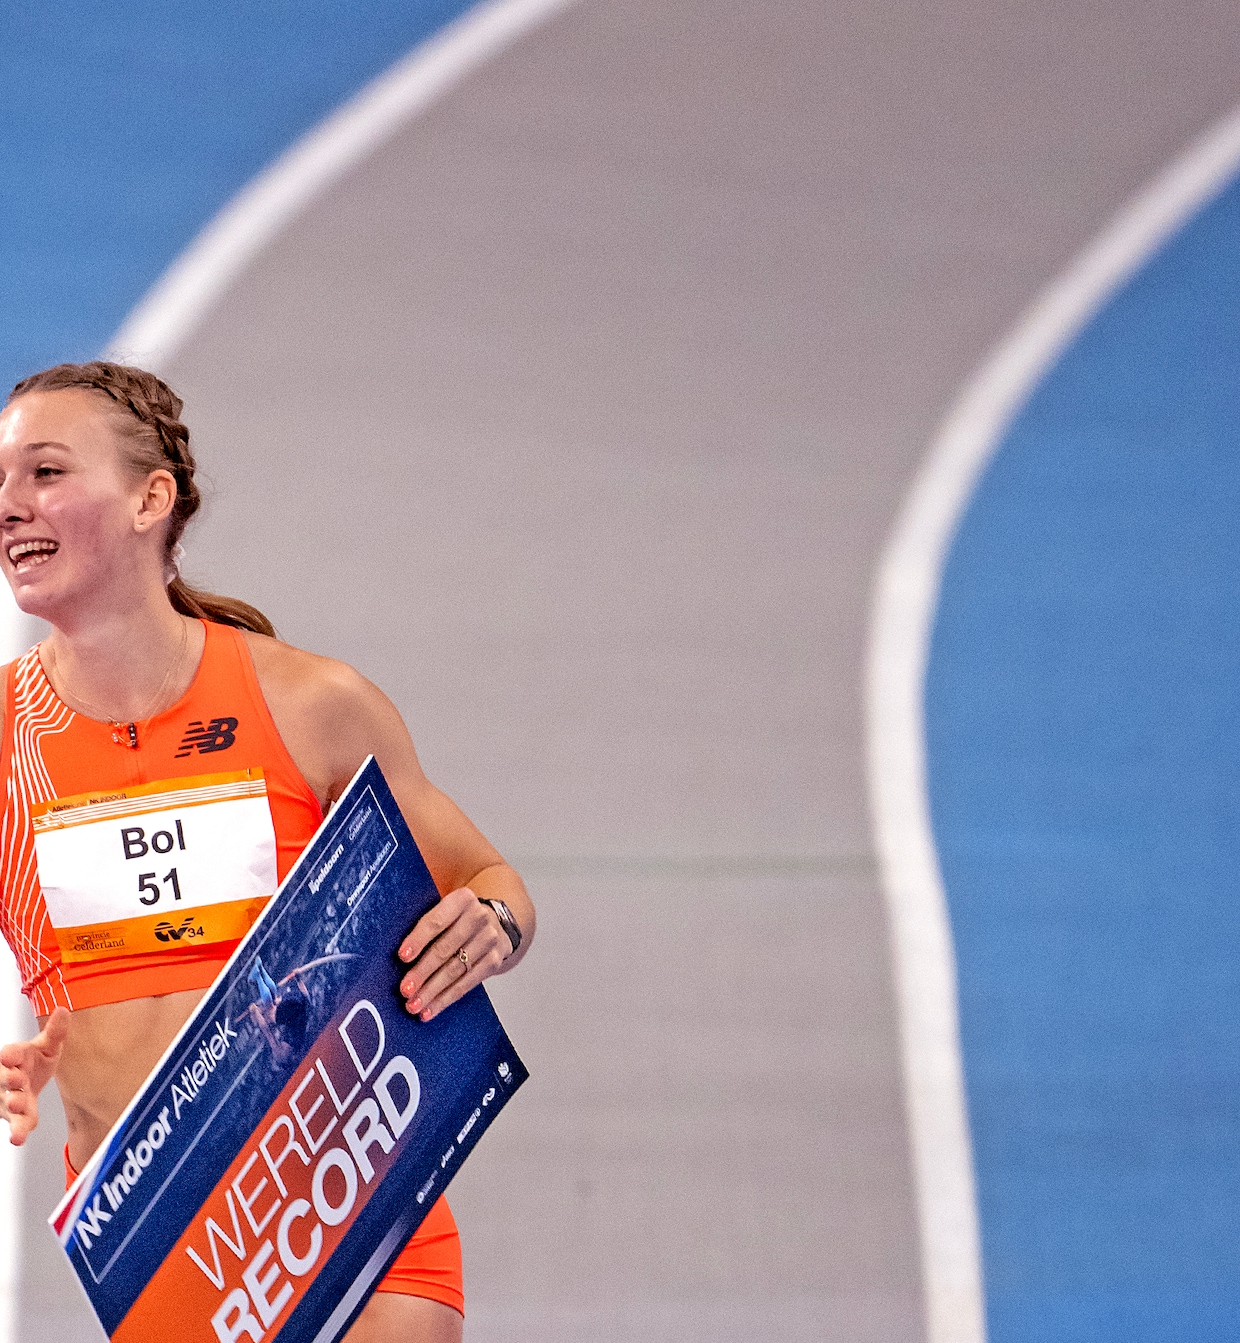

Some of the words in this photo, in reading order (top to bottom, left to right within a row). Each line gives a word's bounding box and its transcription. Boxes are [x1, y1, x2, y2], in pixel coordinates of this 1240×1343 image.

[120, 819, 186, 860] Bol
[138, 867, 182, 906] 51
[71, 1194, 113, 1250] NK
[103, 1106, 173, 1212] Indoor
[171, 1016, 238, 1120] Atletiek
[185, 999, 386, 1291] WERELD
